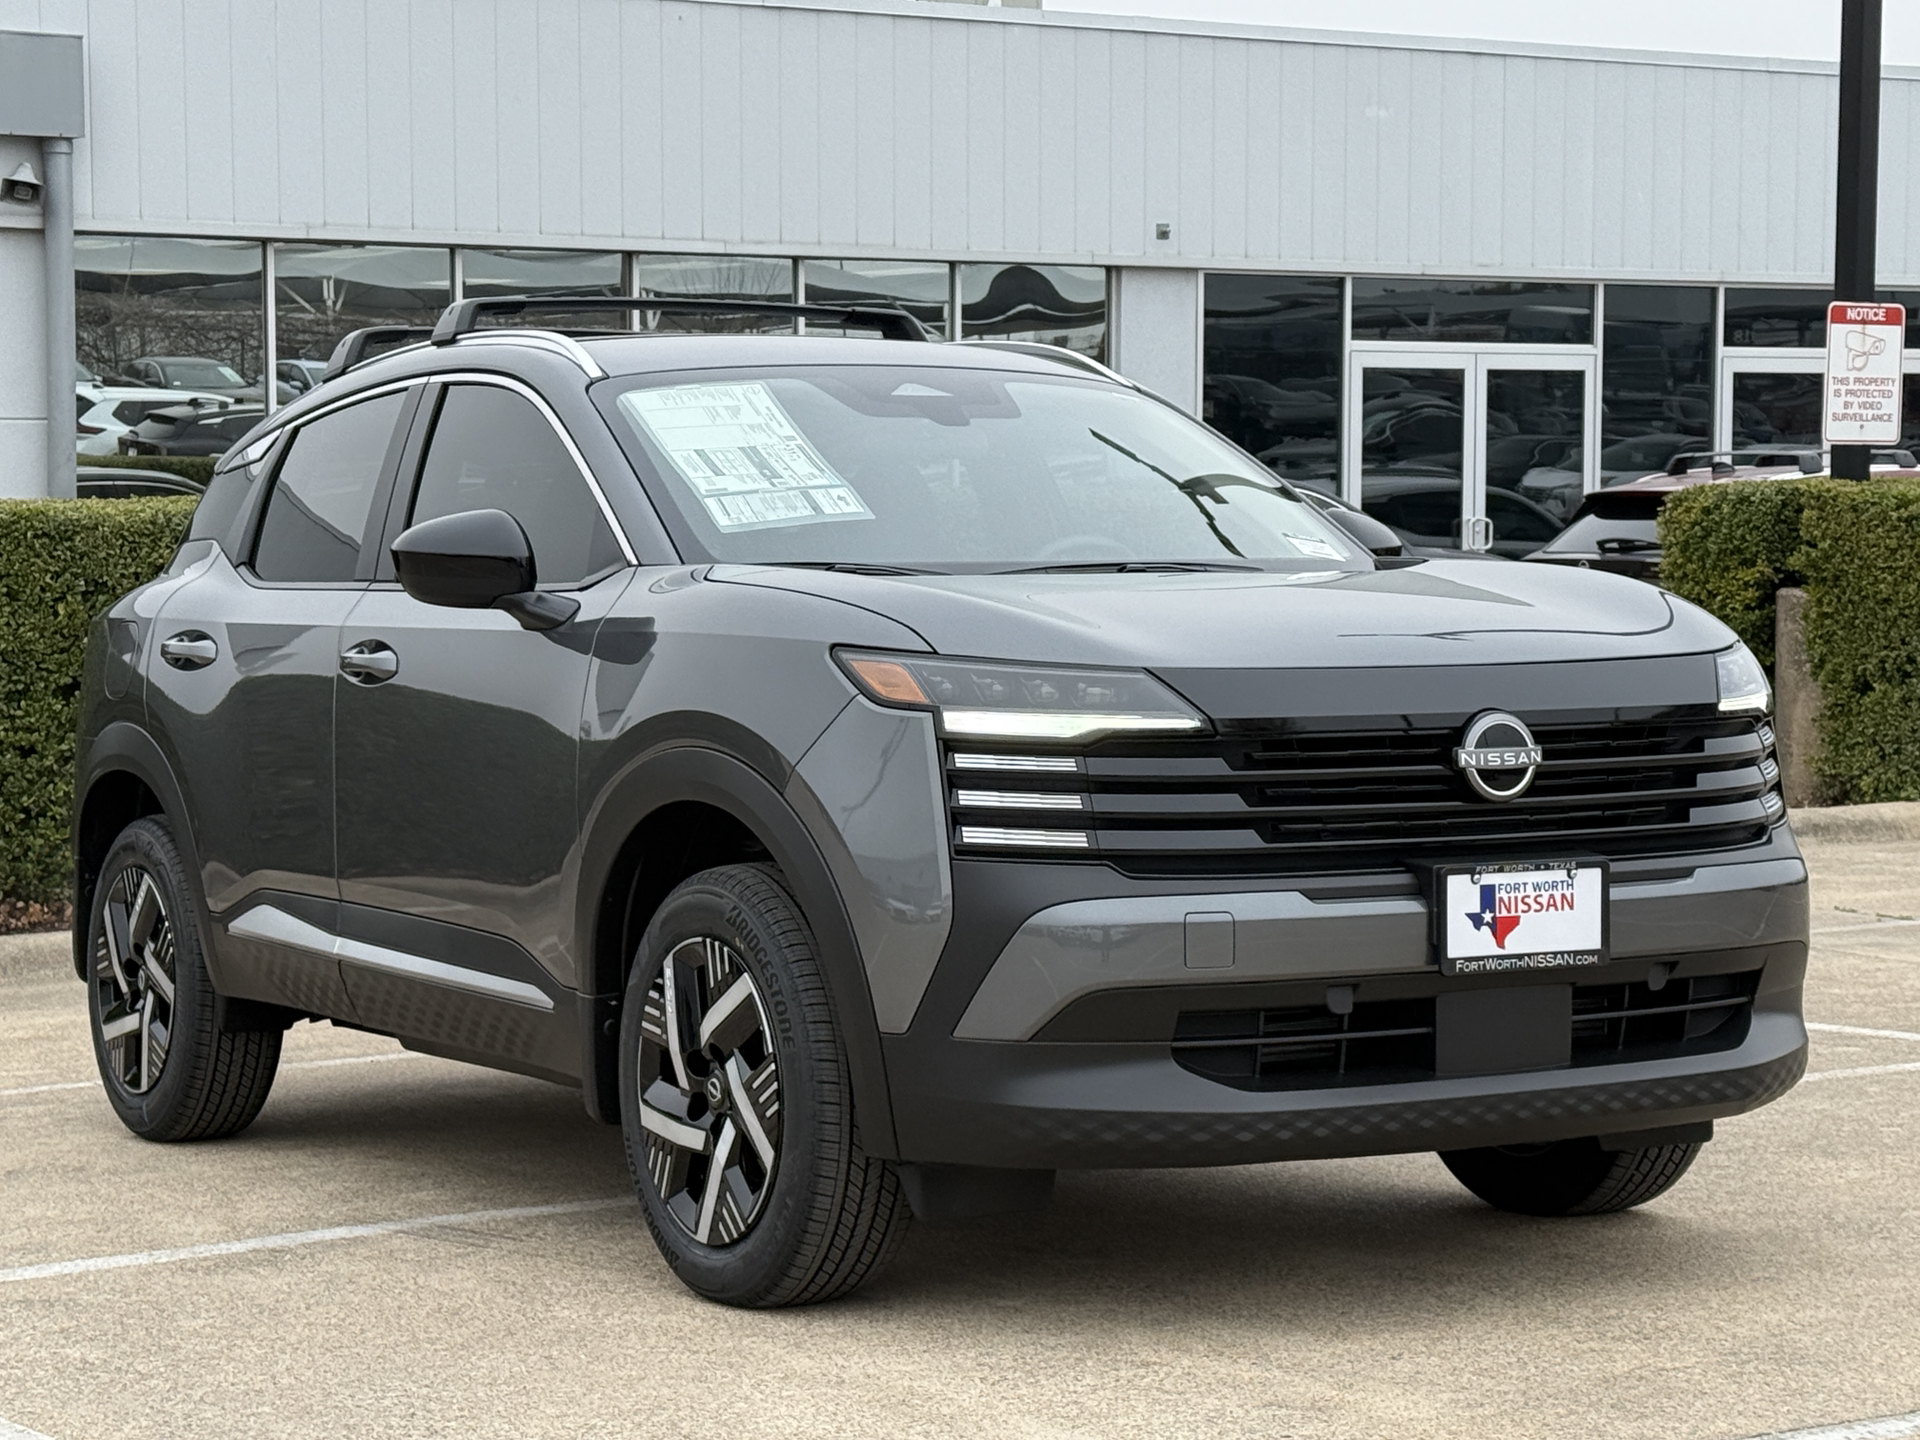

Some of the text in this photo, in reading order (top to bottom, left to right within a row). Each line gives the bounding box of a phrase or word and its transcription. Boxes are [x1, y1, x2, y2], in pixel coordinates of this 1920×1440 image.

[1846, 308, 1887, 321] NOTICE
[1832, 376, 1896, 387] THIS PROPERTY
[1833, 389, 1893, 399] IS PROTECTED
[1843, 401, 1883, 410] BY VIDEO
[1831, 412, 1893, 423] SURVEILLANCE
[1460, 750, 1541, 766] NISSAN
[1475, 861, 1577, 874] FORT WORTH TEXAS
[1497, 880, 1575, 895] FORT WORTH
[1498, 892, 1575, 915] NISSAN
[725, 904, 796, 1049] BRIDGESTONE
